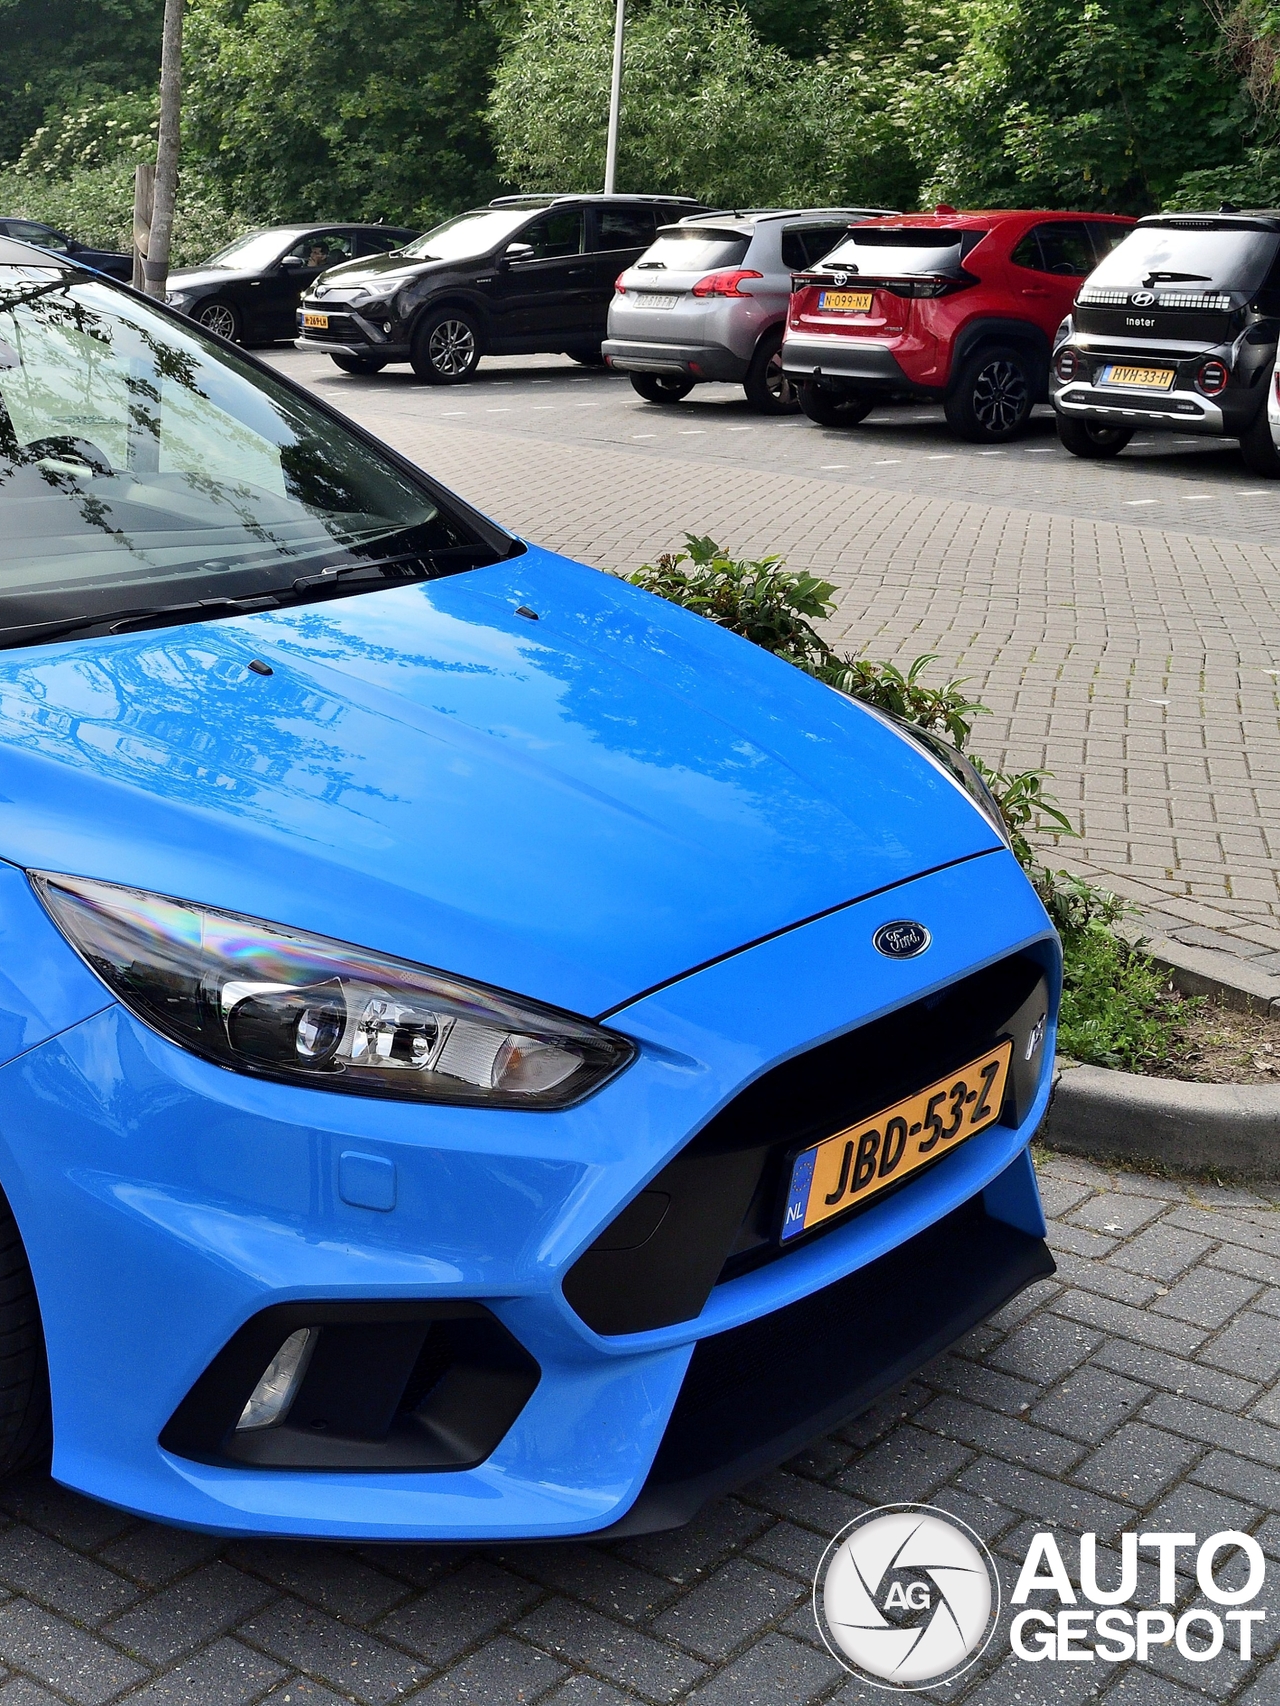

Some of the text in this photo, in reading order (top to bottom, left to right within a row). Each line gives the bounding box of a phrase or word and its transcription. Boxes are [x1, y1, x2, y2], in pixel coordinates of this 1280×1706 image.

[824, 294, 869, 308] N-099-NX
[1112, 367, 1170, 385] HVH-33-H
[885, 927, 920, 952] Ford
[786, 1060, 1000, 1225] NL JBD-53-Z
